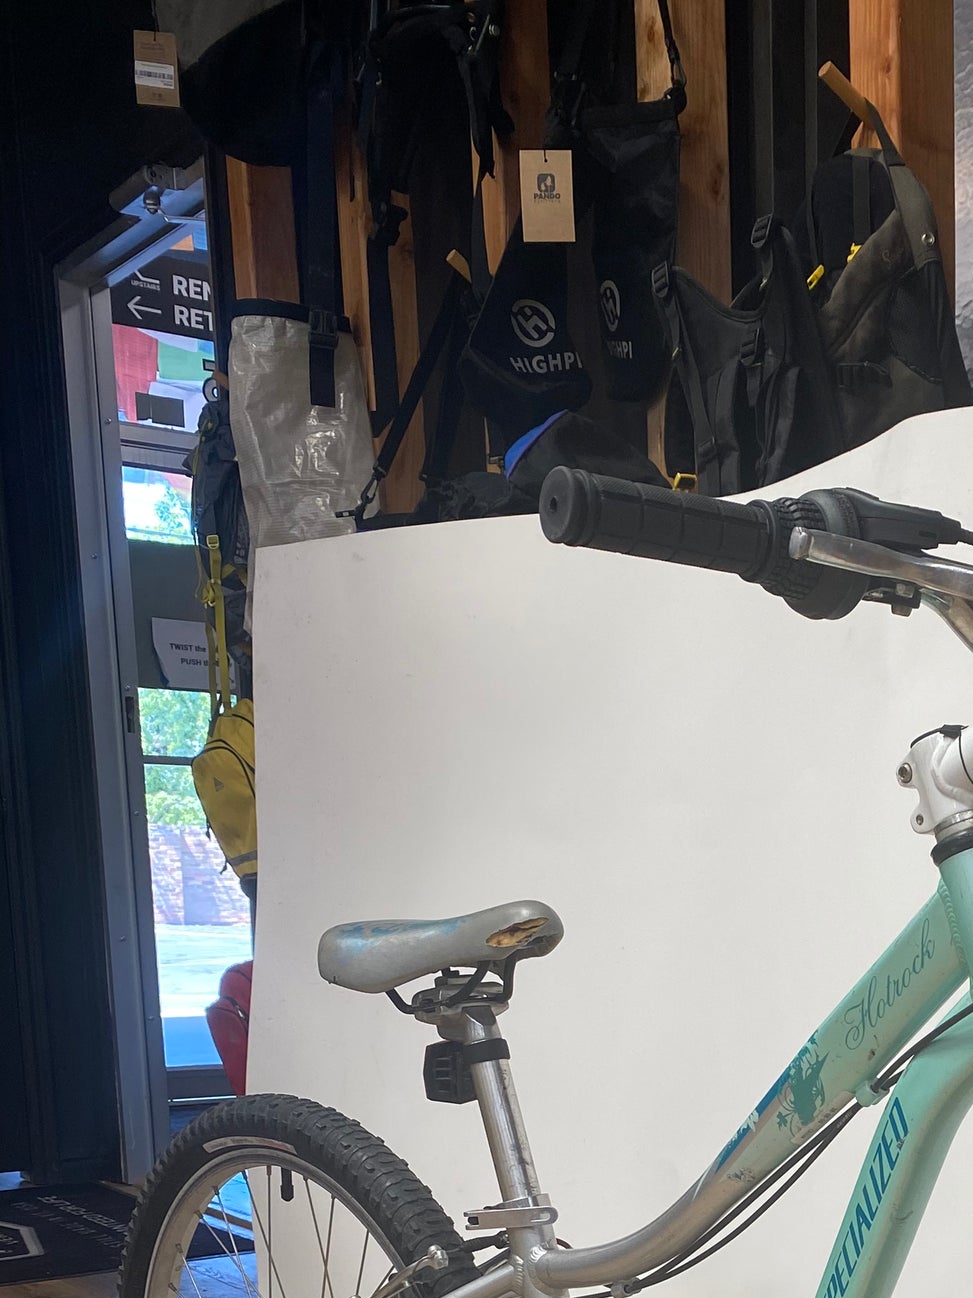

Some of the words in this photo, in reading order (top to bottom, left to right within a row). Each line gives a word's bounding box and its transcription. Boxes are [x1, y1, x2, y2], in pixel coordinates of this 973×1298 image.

[533, 192, 561, 200] PANDO
[169, 643, 192, 652] TWIST
[180, 658, 202, 666] PUSH
[843, 918, 936, 1051] Hotrock
